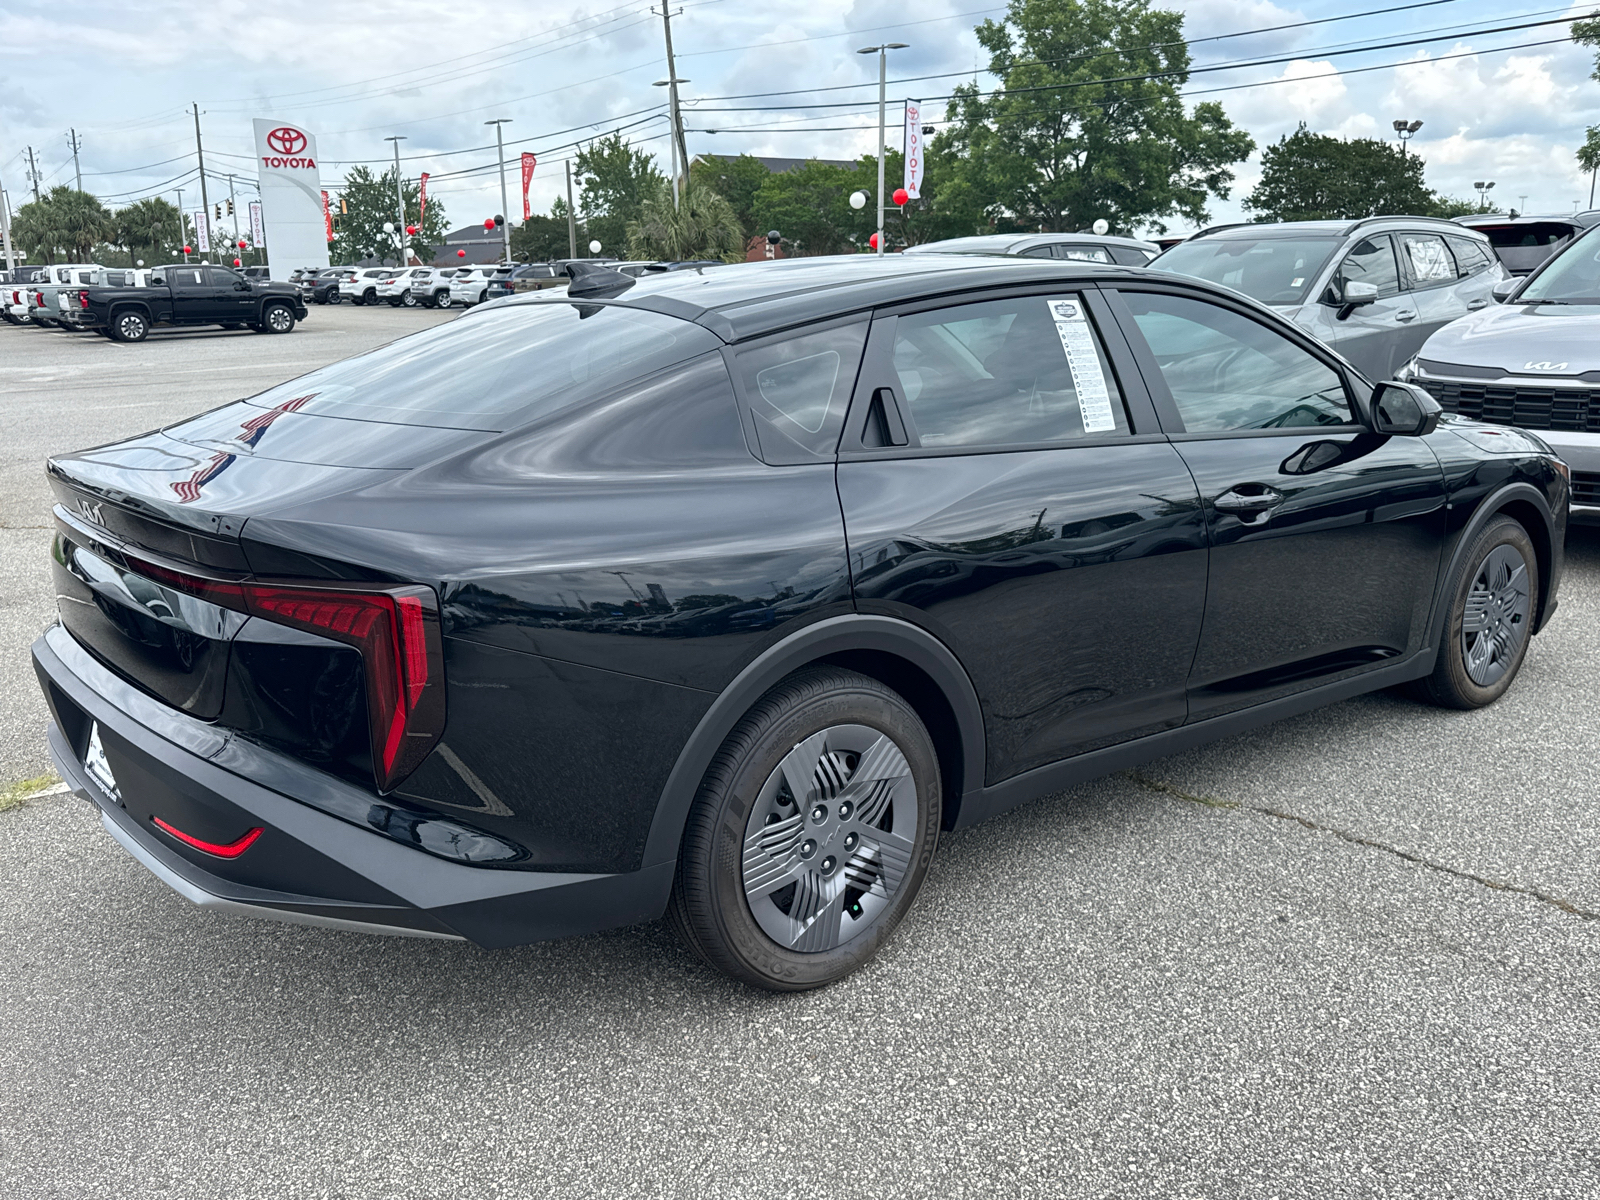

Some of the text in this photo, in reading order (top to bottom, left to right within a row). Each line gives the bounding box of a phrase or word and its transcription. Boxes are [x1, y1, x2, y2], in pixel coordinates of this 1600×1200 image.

[261, 157, 316, 169] TOYOTA
[908, 122, 917, 191] TOYOTA
[1523, 361, 1569, 371] KIA
[920, 781, 938, 869] KUMHO
